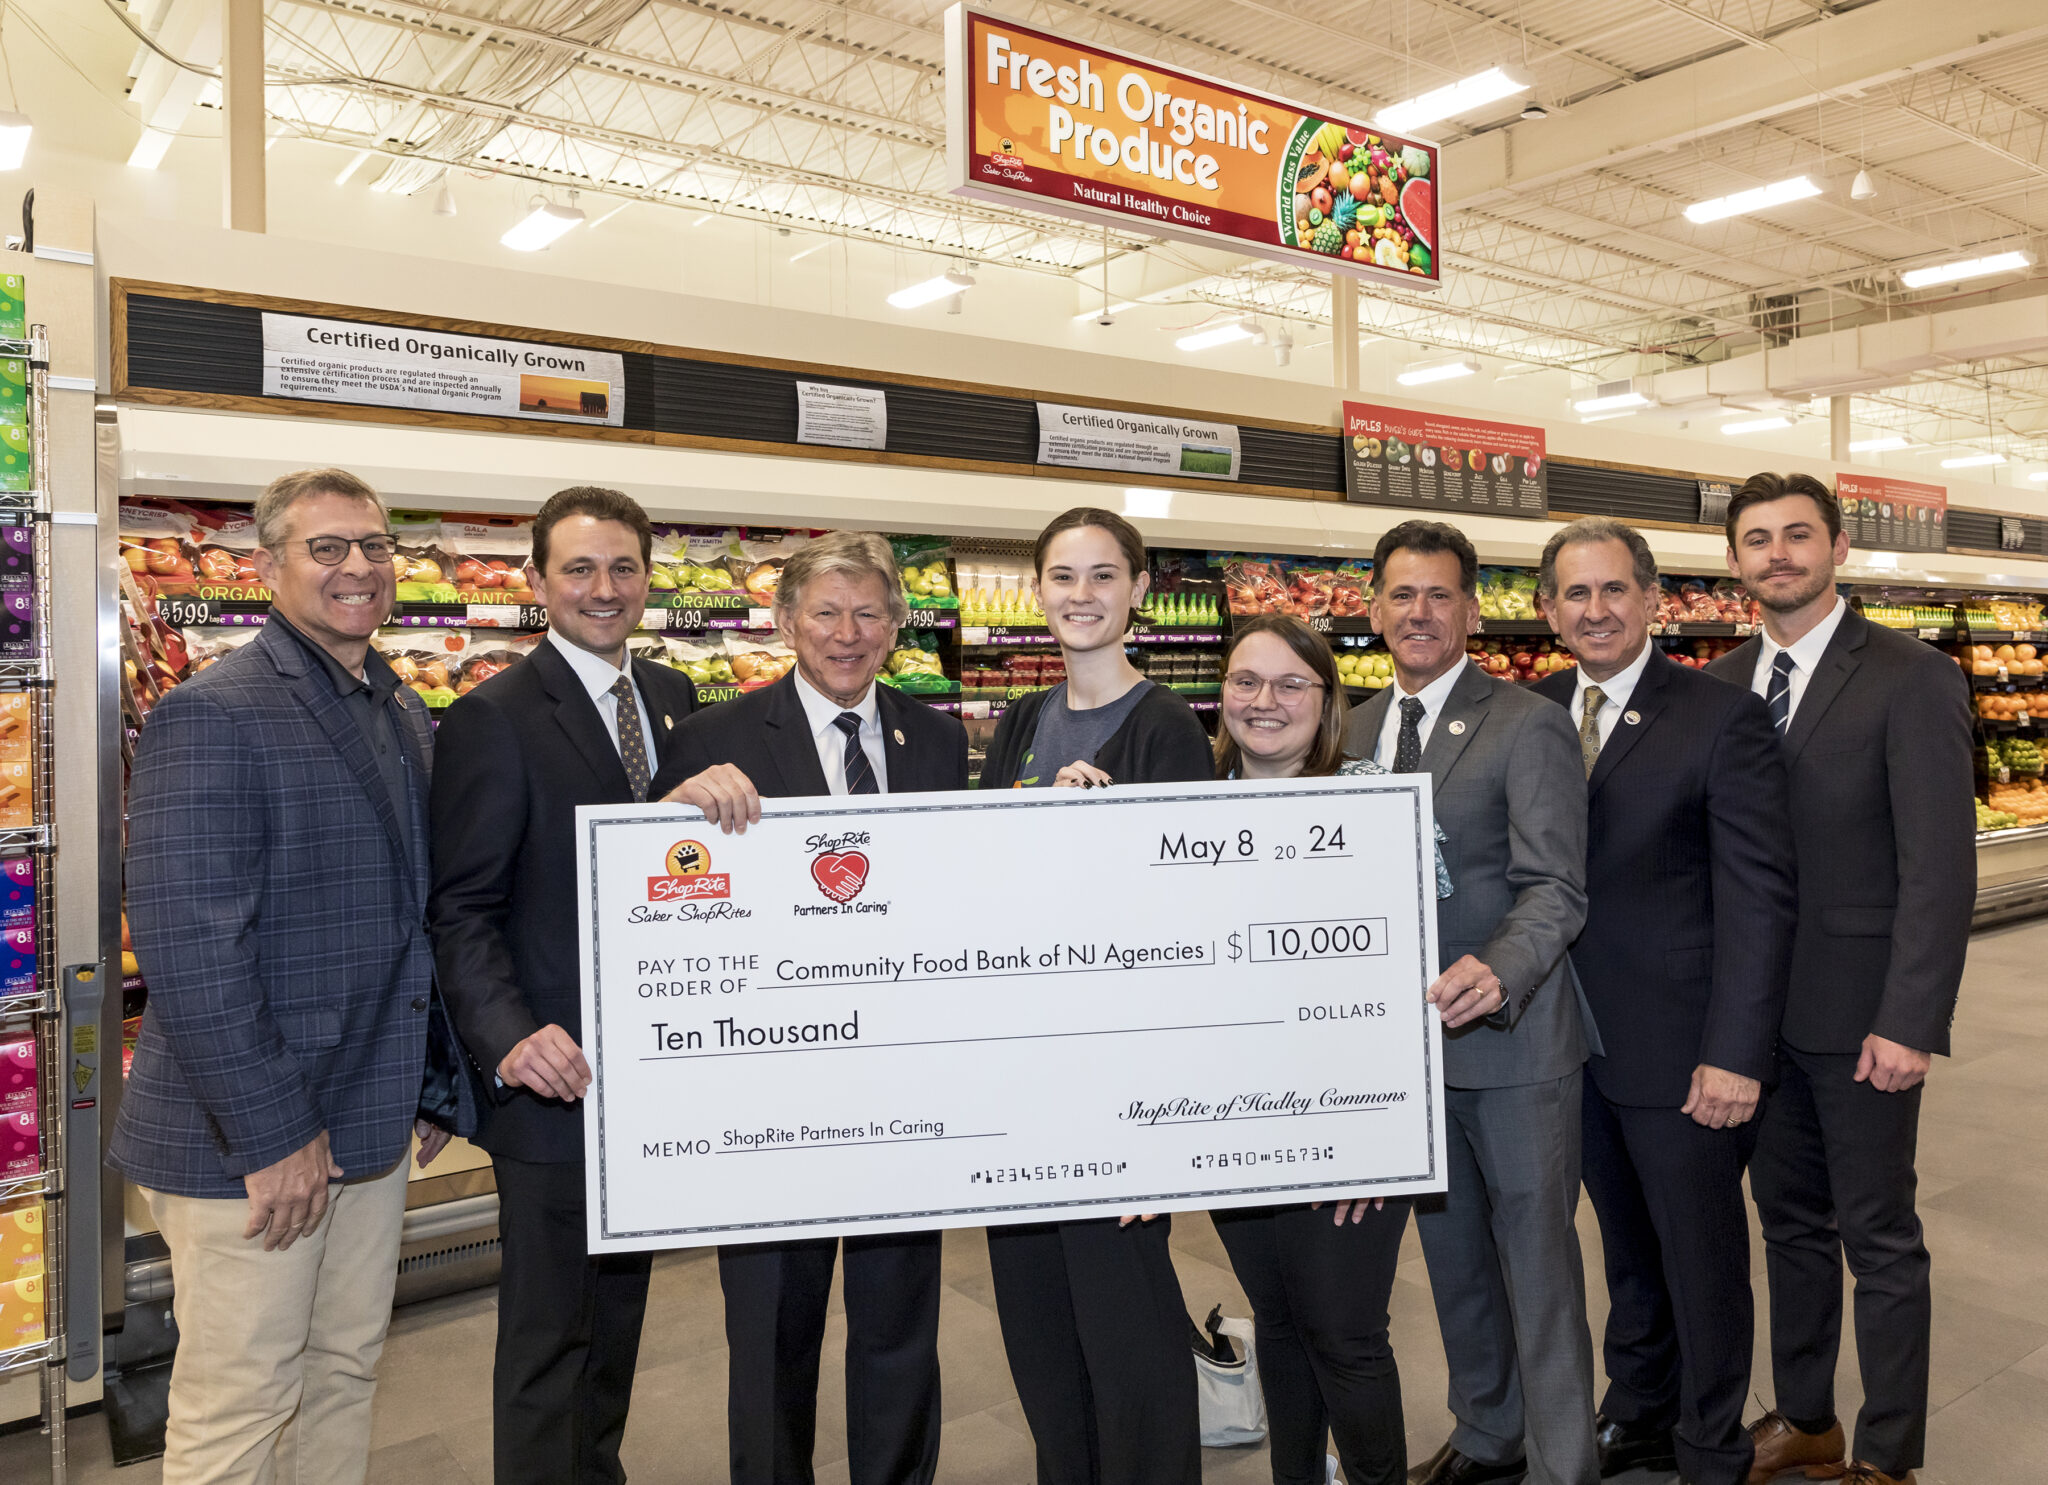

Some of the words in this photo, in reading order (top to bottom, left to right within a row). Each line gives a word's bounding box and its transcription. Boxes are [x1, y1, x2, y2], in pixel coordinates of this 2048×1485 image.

[986, 34, 1104, 112] Fresh
[1117, 74, 1270, 155] Organic
[1049, 104, 1219, 191] Produce
[1289, 130, 1310, 158] Value
[1282, 161, 1297, 193] Class
[1073, 182, 1121, 207] Natural
[1124, 193, 1170, 220] Healthy
[1172, 206, 1211, 226] Choice
[1282, 196, 1293, 237] World
[7, 276, 16, 288] 8
[306, 327, 400, 352] Certified
[405, 339, 519, 367] Organically
[523, 352, 585, 372] Grown
[8, 361, 17, 373] 8
[281, 357, 316, 366] Certified
[318, 361, 347, 370] organic
[350, 364, 382, 374] products
[400, 370, 436, 379] regulated
[438, 373, 467, 383] through
[280, 366, 320, 376] extensive
[322, 370, 369, 381] certification
[372, 374, 400, 383] process
[433, 380, 468, 390] inspected
[470, 384, 501, 394] annually
[280, 383, 337, 394] requirements.
[292, 375, 320, 383] ensure
[321, 377, 340, 387] they
[342, 380, 362, 388] meet
[365, 381, 378, 389] the
[380, 382, 406, 392] USDA's
[408, 385, 440, 395] National
[442, 388, 469, 398] Organic
[471, 392, 502, 401] Program
[1062, 412, 1114, 429] Certified
[1117, 418, 1180, 438] Organically
[1182, 426, 1218, 440] Grown
[1350, 416, 1382, 432] APPLES
[11, 429, 20, 440] 8
[14, 530, 23, 542] 8
[464, 525, 488, 533] GALA
[15, 597, 24, 609] 8
[201, 587, 272, 601] ORGAN
[432, 591, 514, 604] ORGANIC
[672, 595, 741, 608] ORGANIC
[710, 620, 736, 628] Organic
[12, 696, 21, 709] 8
[13, 764, 23, 776] 8
[804, 830, 871, 853] ShopRite
[1160, 831, 1226, 866] May
[1238, 829, 1254, 857] 8
[1274, 845, 1297, 861] 20
[1309, 824, 1346, 852] 24
[16, 863, 25, 875] 8
[652, 876, 728, 902] ShopRite
[628, 904, 673, 924] Saker
[677, 901, 752, 923] ShopRites
[794, 903, 838, 917] Partners
[840, 902, 853, 915] In
[856, 901, 888, 917] Caring
[17, 931, 27, 943] 8
[1266, 924, 1371, 959] 10,000
[638, 959, 676, 976] PAY
[683, 957, 711, 973] TO
[719, 954, 760, 971] THE
[776, 957, 905, 983] Community
[912, 949, 968, 974] Food
[976, 945, 1031, 971] Bank
[1039, 943, 1062, 967] of
[1068, 944, 1096, 967] NJ
[1104, 941, 1204, 969] Agencies
[638, 980, 712, 999] ORDER
[720, 978, 748, 993] OF
[1298, 1002, 1386, 1022] DOLLARS
[651, 1022, 703, 1051] Ten
[713, 1009, 859, 1048] Thousand
[18, 1045, 28, 1058] 8
[1118, 1098, 1212, 1126] ShopRite
[1213, 1093, 1241, 1121] of
[1238, 1090, 1312, 1116] Hadley
[1318, 1087, 1408, 1110] Commons
[20, 1113, 29, 1125] 8
[642, 1139, 711, 1159] MEMO
[722, 1126, 795, 1149] ShopRite
[800, 1122, 865, 1142] Partners
[869, 1121, 884, 1137] In
[889, 1118, 945, 1137] Caring
[25, 1211, 34, 1223] 8
[26, 1280, 35, 1293] 8
